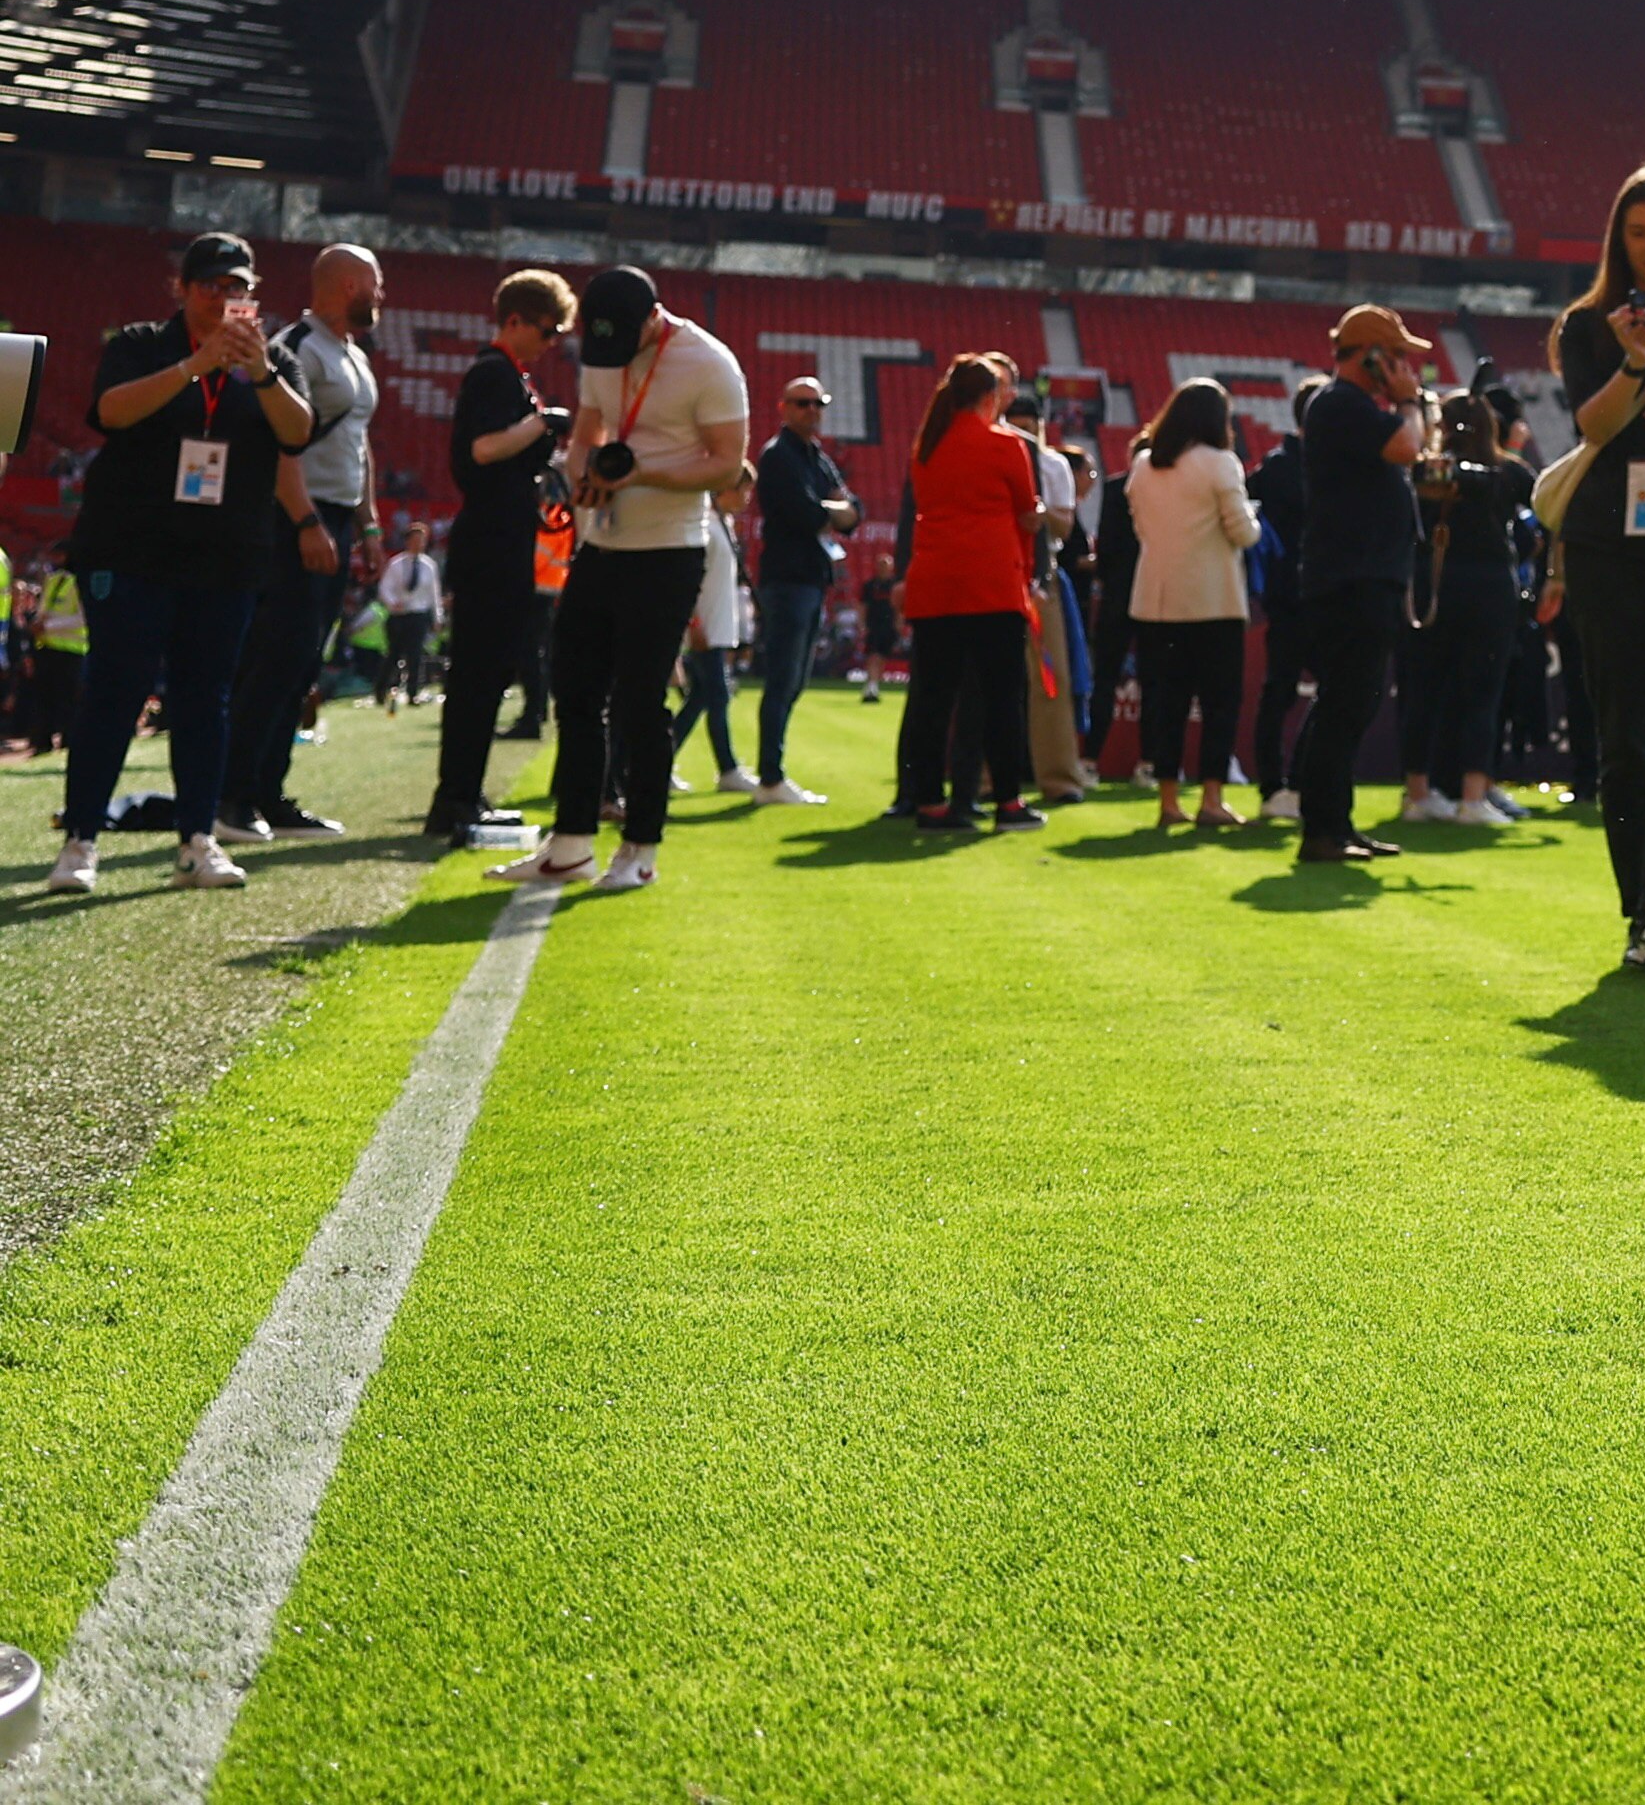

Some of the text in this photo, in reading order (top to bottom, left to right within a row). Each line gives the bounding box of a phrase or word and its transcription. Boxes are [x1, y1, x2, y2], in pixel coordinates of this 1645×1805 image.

[443, 164, 944, 223] ONE LOVE STRETFORD END MUFC
[1015, 201, 1475, 257] REPUBLIC OF MANCUNIA RED ARMY
